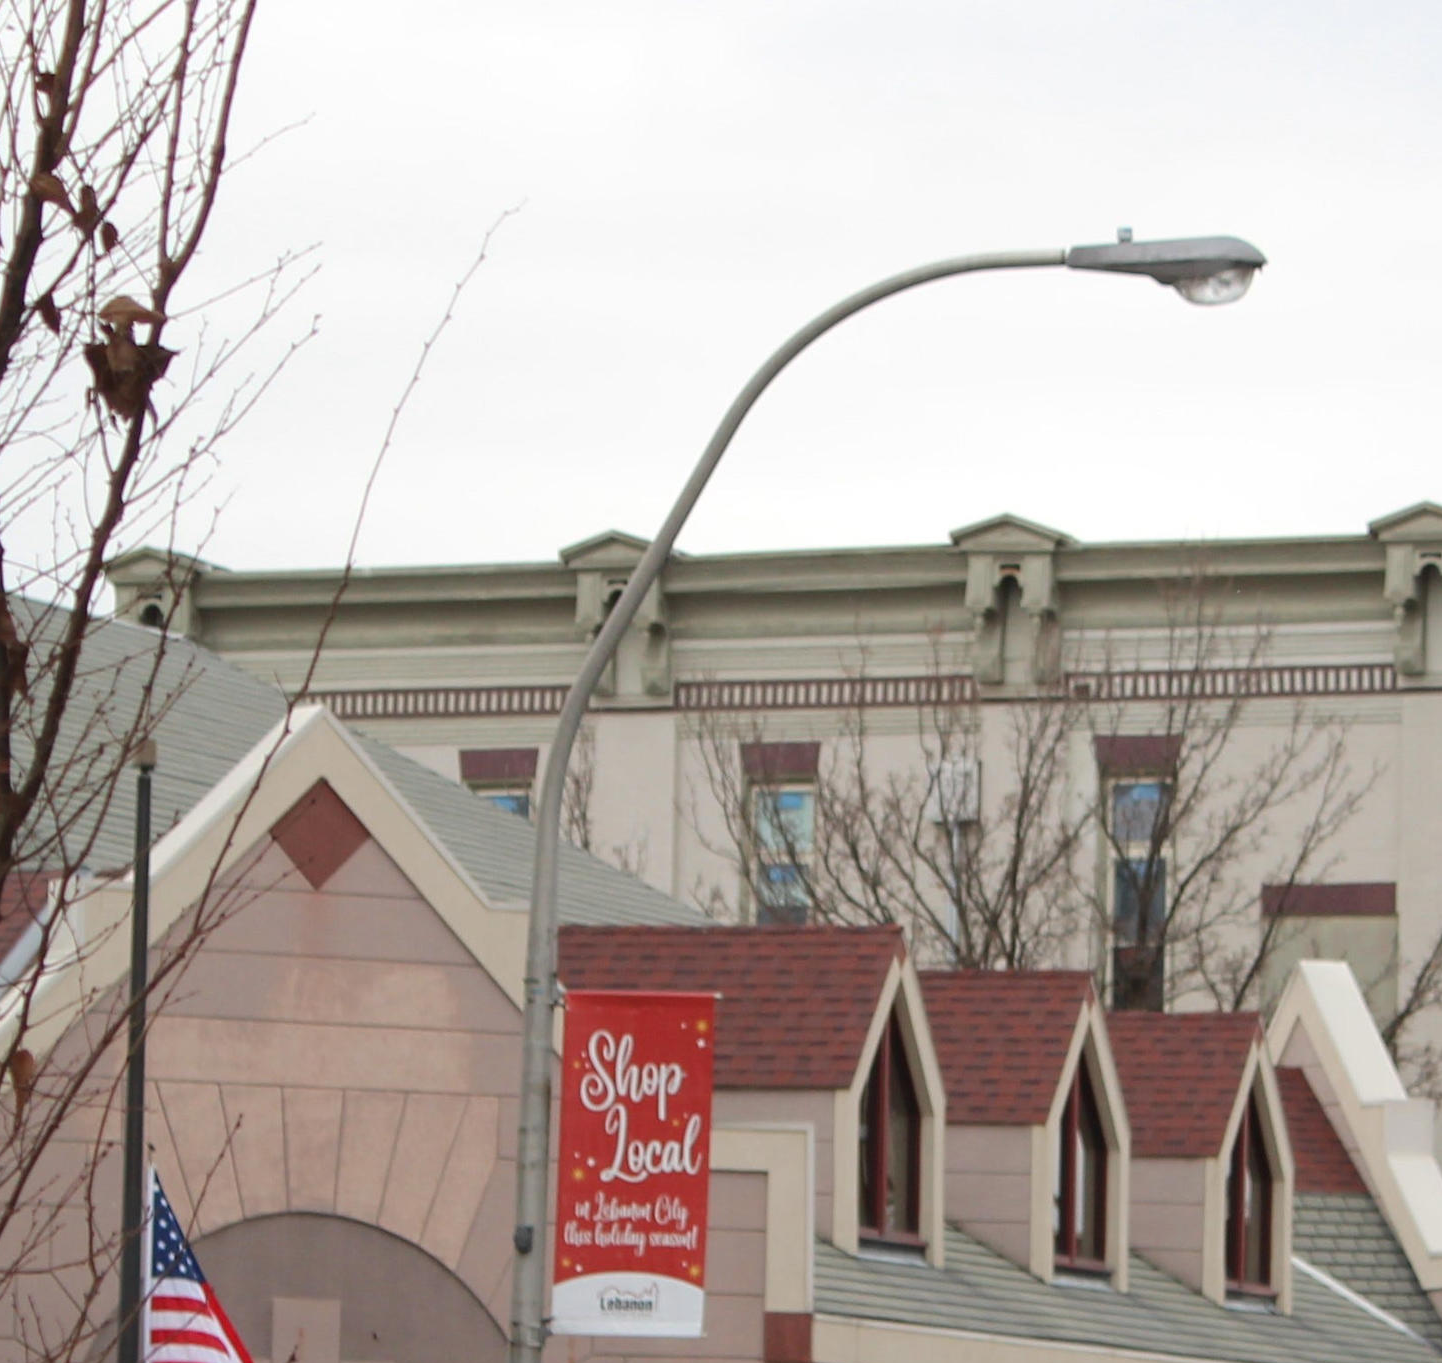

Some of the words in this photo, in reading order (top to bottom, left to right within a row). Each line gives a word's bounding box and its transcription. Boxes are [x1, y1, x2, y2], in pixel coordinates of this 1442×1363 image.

[580, 1029, 686, 1121] Shop
[600, 1103, 702, 1183] Local
[593, 1190, 652, 1222] Lebanon
[654, 1194, 688, 1230] City
[595, 1221, 646, 1257] holiday
[600, 1297, 653, 1311] Lebanon
